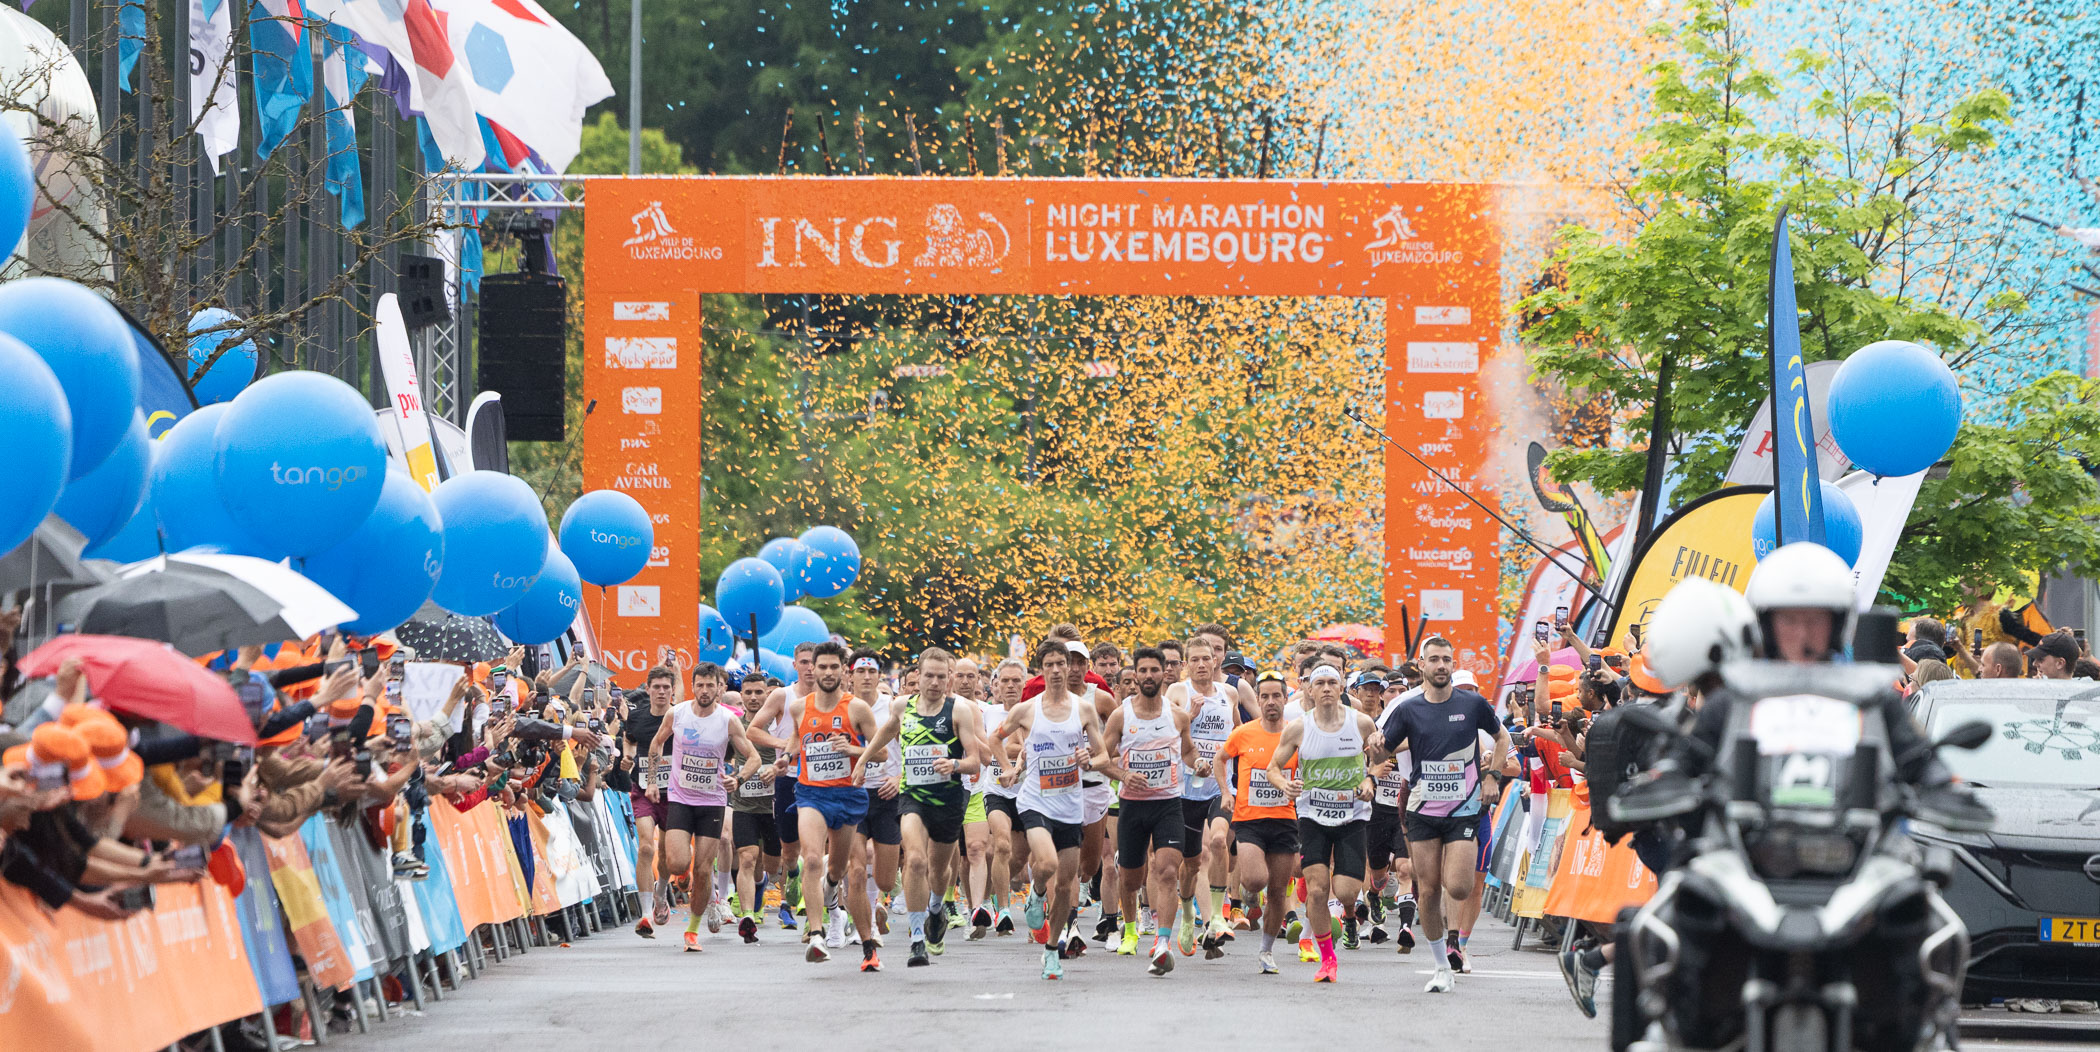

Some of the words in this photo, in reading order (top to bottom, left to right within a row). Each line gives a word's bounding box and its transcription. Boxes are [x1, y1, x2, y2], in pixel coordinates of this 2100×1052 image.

[1046, 203, 1141, 228] NIGHT
[1152, 203, 1325, 228] MARATHON
[756, 216, 904, 268] ING
[1046, 231, 1325, 263] LUXEMBOURG
[1422, 443, 1454, 457] pwc
[269, 461, 358, 491] tango
[1427, 467, 1461, 480] CAR
[614, 475, 672, 489] AVENUE
[1416, 480, 1475, 493] AVENUE
[1430, 518, 1472, 529] enovos
[590, 529, 637, 549] tango
[1409, 547, 1472, 563] luxcargo
[558, 589, 578, 611] tan
[602, 649, 648, 672] NG
[809, 745, 830, 755] ING
[908, 747, 929, 758] ING
[684, 756, 704, 767] ING
[1132, 752, 1153, 761] ING
[813, 760, 844, 773] 6492
[1042, 759, 1065, 770] ING
[1131, 761, 1169, 769] LUXEMBOURG
[1424, 764, 1445, 773] ING
[913, 766, 934, 776] 699
[1254, 772, 1267, 780] IN
[685, 772, 712, 784] 6966
[1387, 773, 1401, 782] NG
[1427, 782, 1459, 792] 5996
[1313, 790, 1334, 801] ING
[1312, 801, 1351, 809] LUXEMBOURG
[1315, 808, 1346, 819] 7420
[2062, 920, 2088, 940] ZT
